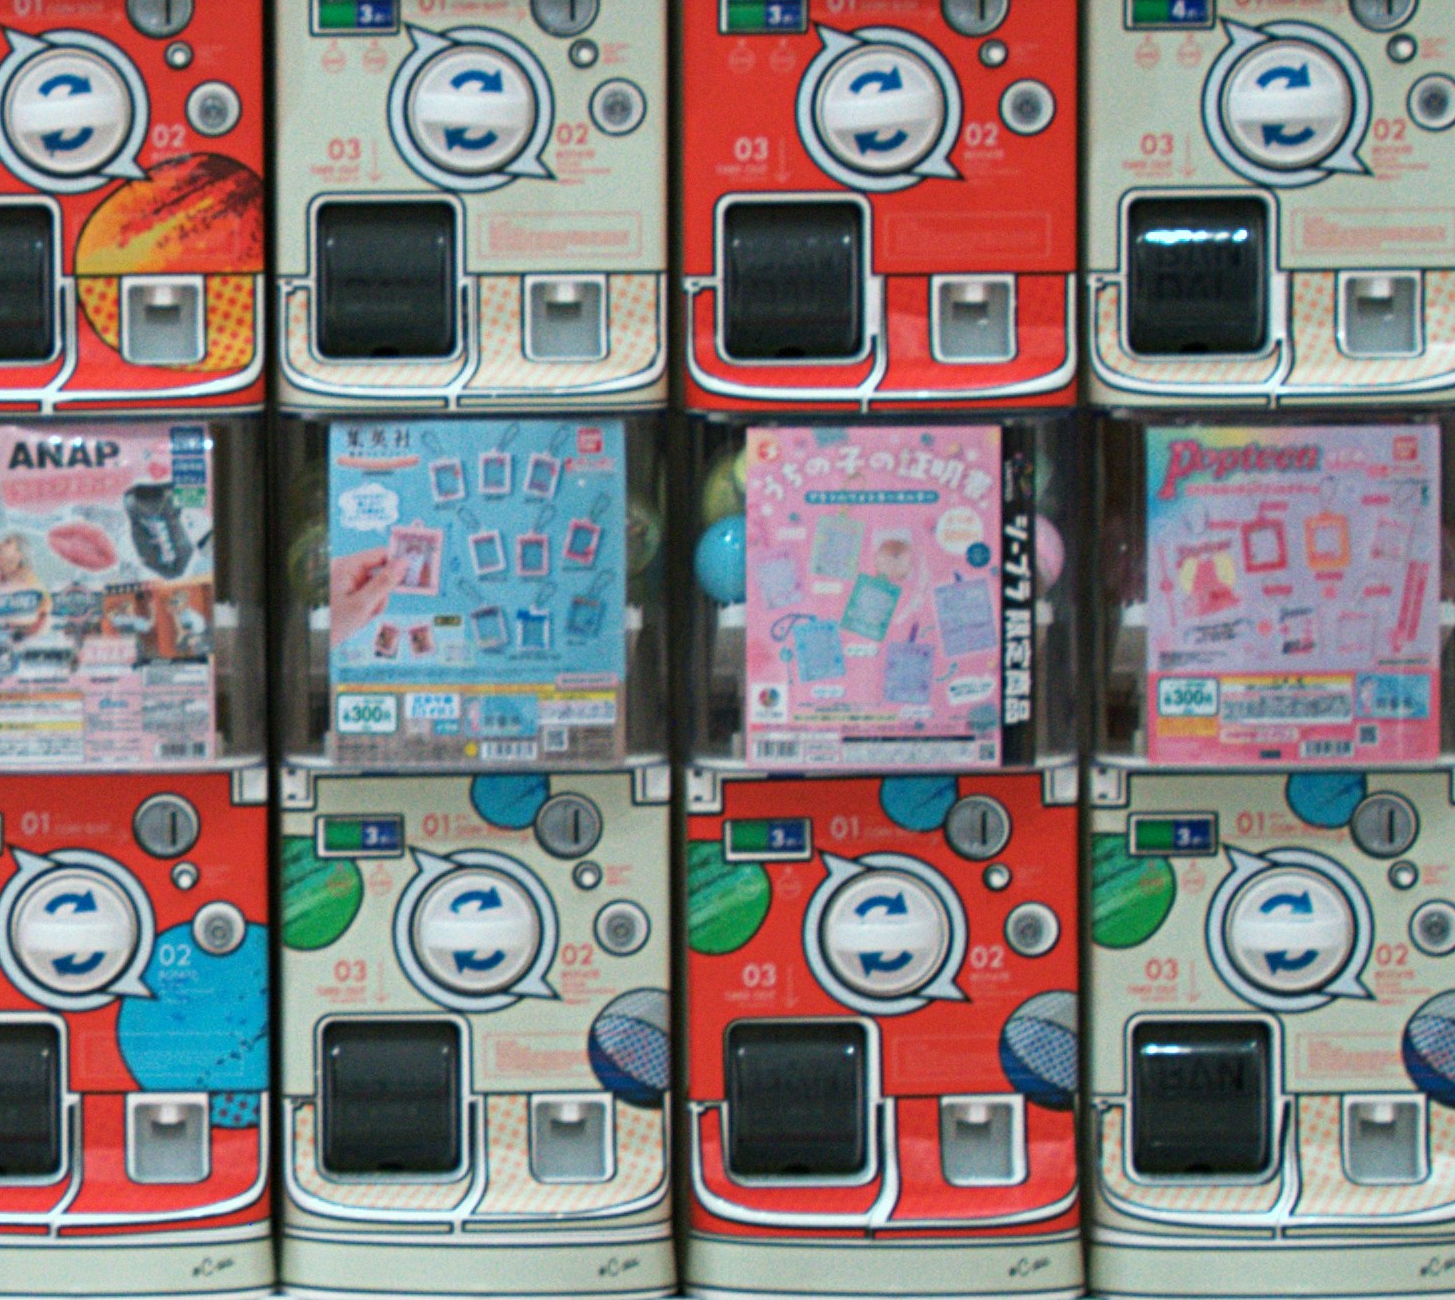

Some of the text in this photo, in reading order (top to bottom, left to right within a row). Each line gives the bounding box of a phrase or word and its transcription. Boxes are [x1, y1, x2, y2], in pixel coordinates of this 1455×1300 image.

[152, 124, 185, 148] 02
[965, 123, 998, 147] 02
[734, 137, 768, 161] 03
[8, 440, 120, 470] ANAP
[1159, 439, 1323, 498] Popteen
[21, 812, 49, 836] 01
[159, 944, 191, 966] 02
[970, 945, 1004, 969] 02
[742, 963, 776, 987] 03
